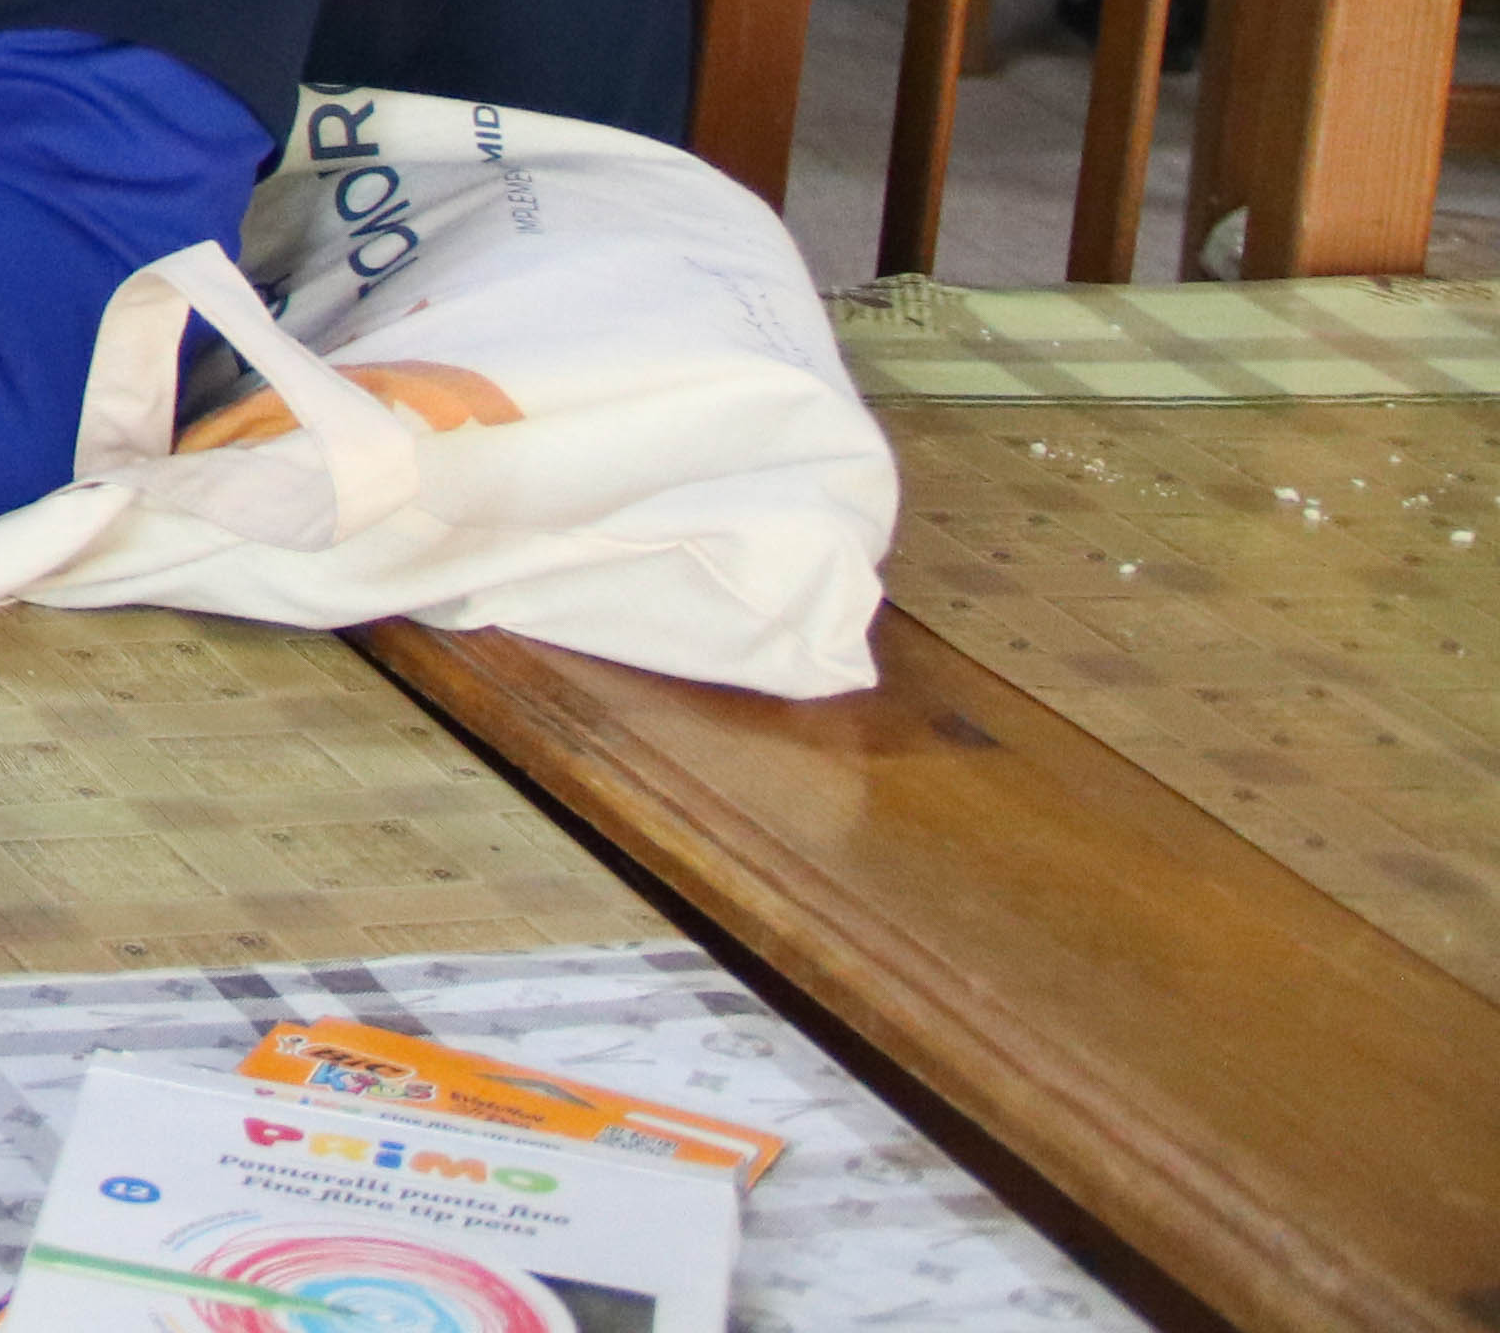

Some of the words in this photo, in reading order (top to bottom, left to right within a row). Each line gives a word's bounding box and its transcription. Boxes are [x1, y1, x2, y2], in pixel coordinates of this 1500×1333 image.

[219, 1153, 392, 1194] Pennarelli
[399, 1187, 498, 1214] punta
[242, 1174, 311, 1198] Fine
[313, 1187, 395, 1211] fibre
[410, 1202, 455, 1223] tip
[463, 1214, 539, 1237] pens
